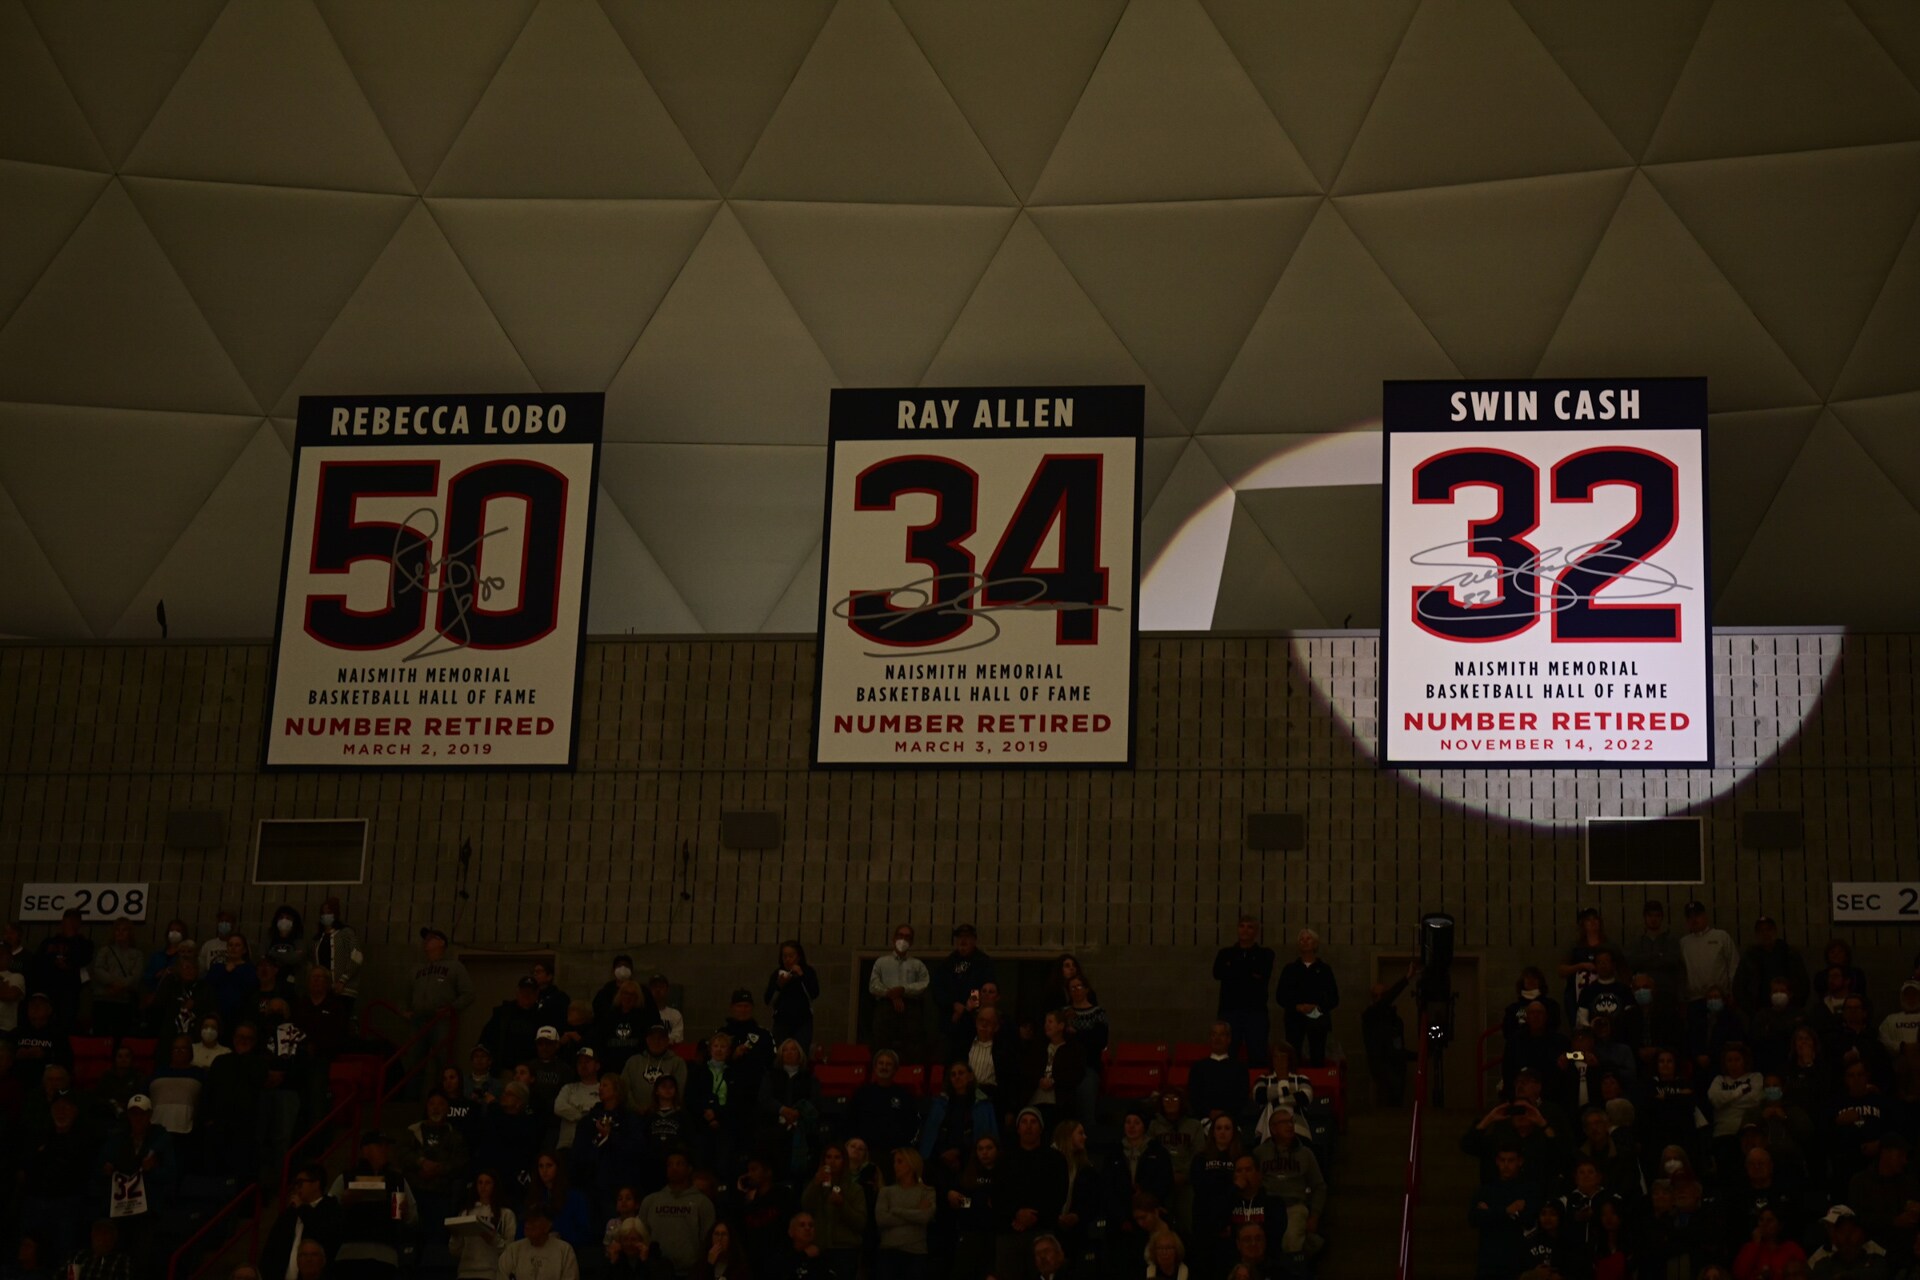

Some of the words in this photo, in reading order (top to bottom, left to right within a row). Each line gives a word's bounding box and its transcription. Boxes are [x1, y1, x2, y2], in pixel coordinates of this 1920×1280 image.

[898, 400, 959, 428] RAY
[973, 399, 1073, 428] ALLEN
[1451, 391, 1537, 421] SWIN
[1555, 390, 1639, 420] CASH
[331, 406, 469, 435] REBECCA
[485, 405, 566, 433] LOBO
[848, 453, 1109, 646] 34
[1411, 445, 1682, 643] 32
[303, 459, 569, 651] 50
[338, 668, 416, 683] NAISMITH
[426, 668, 509, 682] MEMORIAL
[886, 665, 966, 679] NAISMITH
[977, 664, 1062, 679] MEMORIAL
[1455, 662, 1537, 676] NAISMITH
[1549, 661, 1637, 675] MEMORIAL
[309, 690, 409, 704] BASKETBALL
[419, 690, 457, 704] HALL
[468, 690, 485, 704] OF
[495, 690, 535, 704] FAME
[857, 687, 960, 701] BASKETBALL
[971, 687, 1010, 701] HALL
[1020, 686, 1038, 701] OF
[1049, 686, 1090, 701] FAME
[1427, 684, 1532, 698] BASKETBALL
[1544, 684, 1584, 698] HALL
[1595, 684, 1613, 698] OF
[1625, 684, 1666, 698] FAME
[285, 718, 411, 735] NUMBER
[425, 718, 554, 735] RETIRED
[835, 715, 963, 733] NUMBER
[978, 715, 1111, 732] RETIRED
[1405, 713, 1537, 730] NUMBER
[1553, 712, 1689, 730] RETIRED
[344, 744, 410, 754] MARCH
[421, 744, 436, 756] 2,
[448, 744, 491, 754] 2019
[896, 742, 963, 752] MARCH
[976, 741, 991, 753] 3,
[1003, 741, 1047, 752] 2019
[1441, 739, 1553, 750] NOVEMBER
[1566, 739, 1592, 751] 14,
[1605, 739, 1653, 751] 2022
[24, 896, 64, 911] SEC
[74, 889, 143, 915] 208
[1837, 895, 1880, 910] SEC
[114, 1174, 142, 1201] 32
[655, 1205, 692, 1214] UCONN
